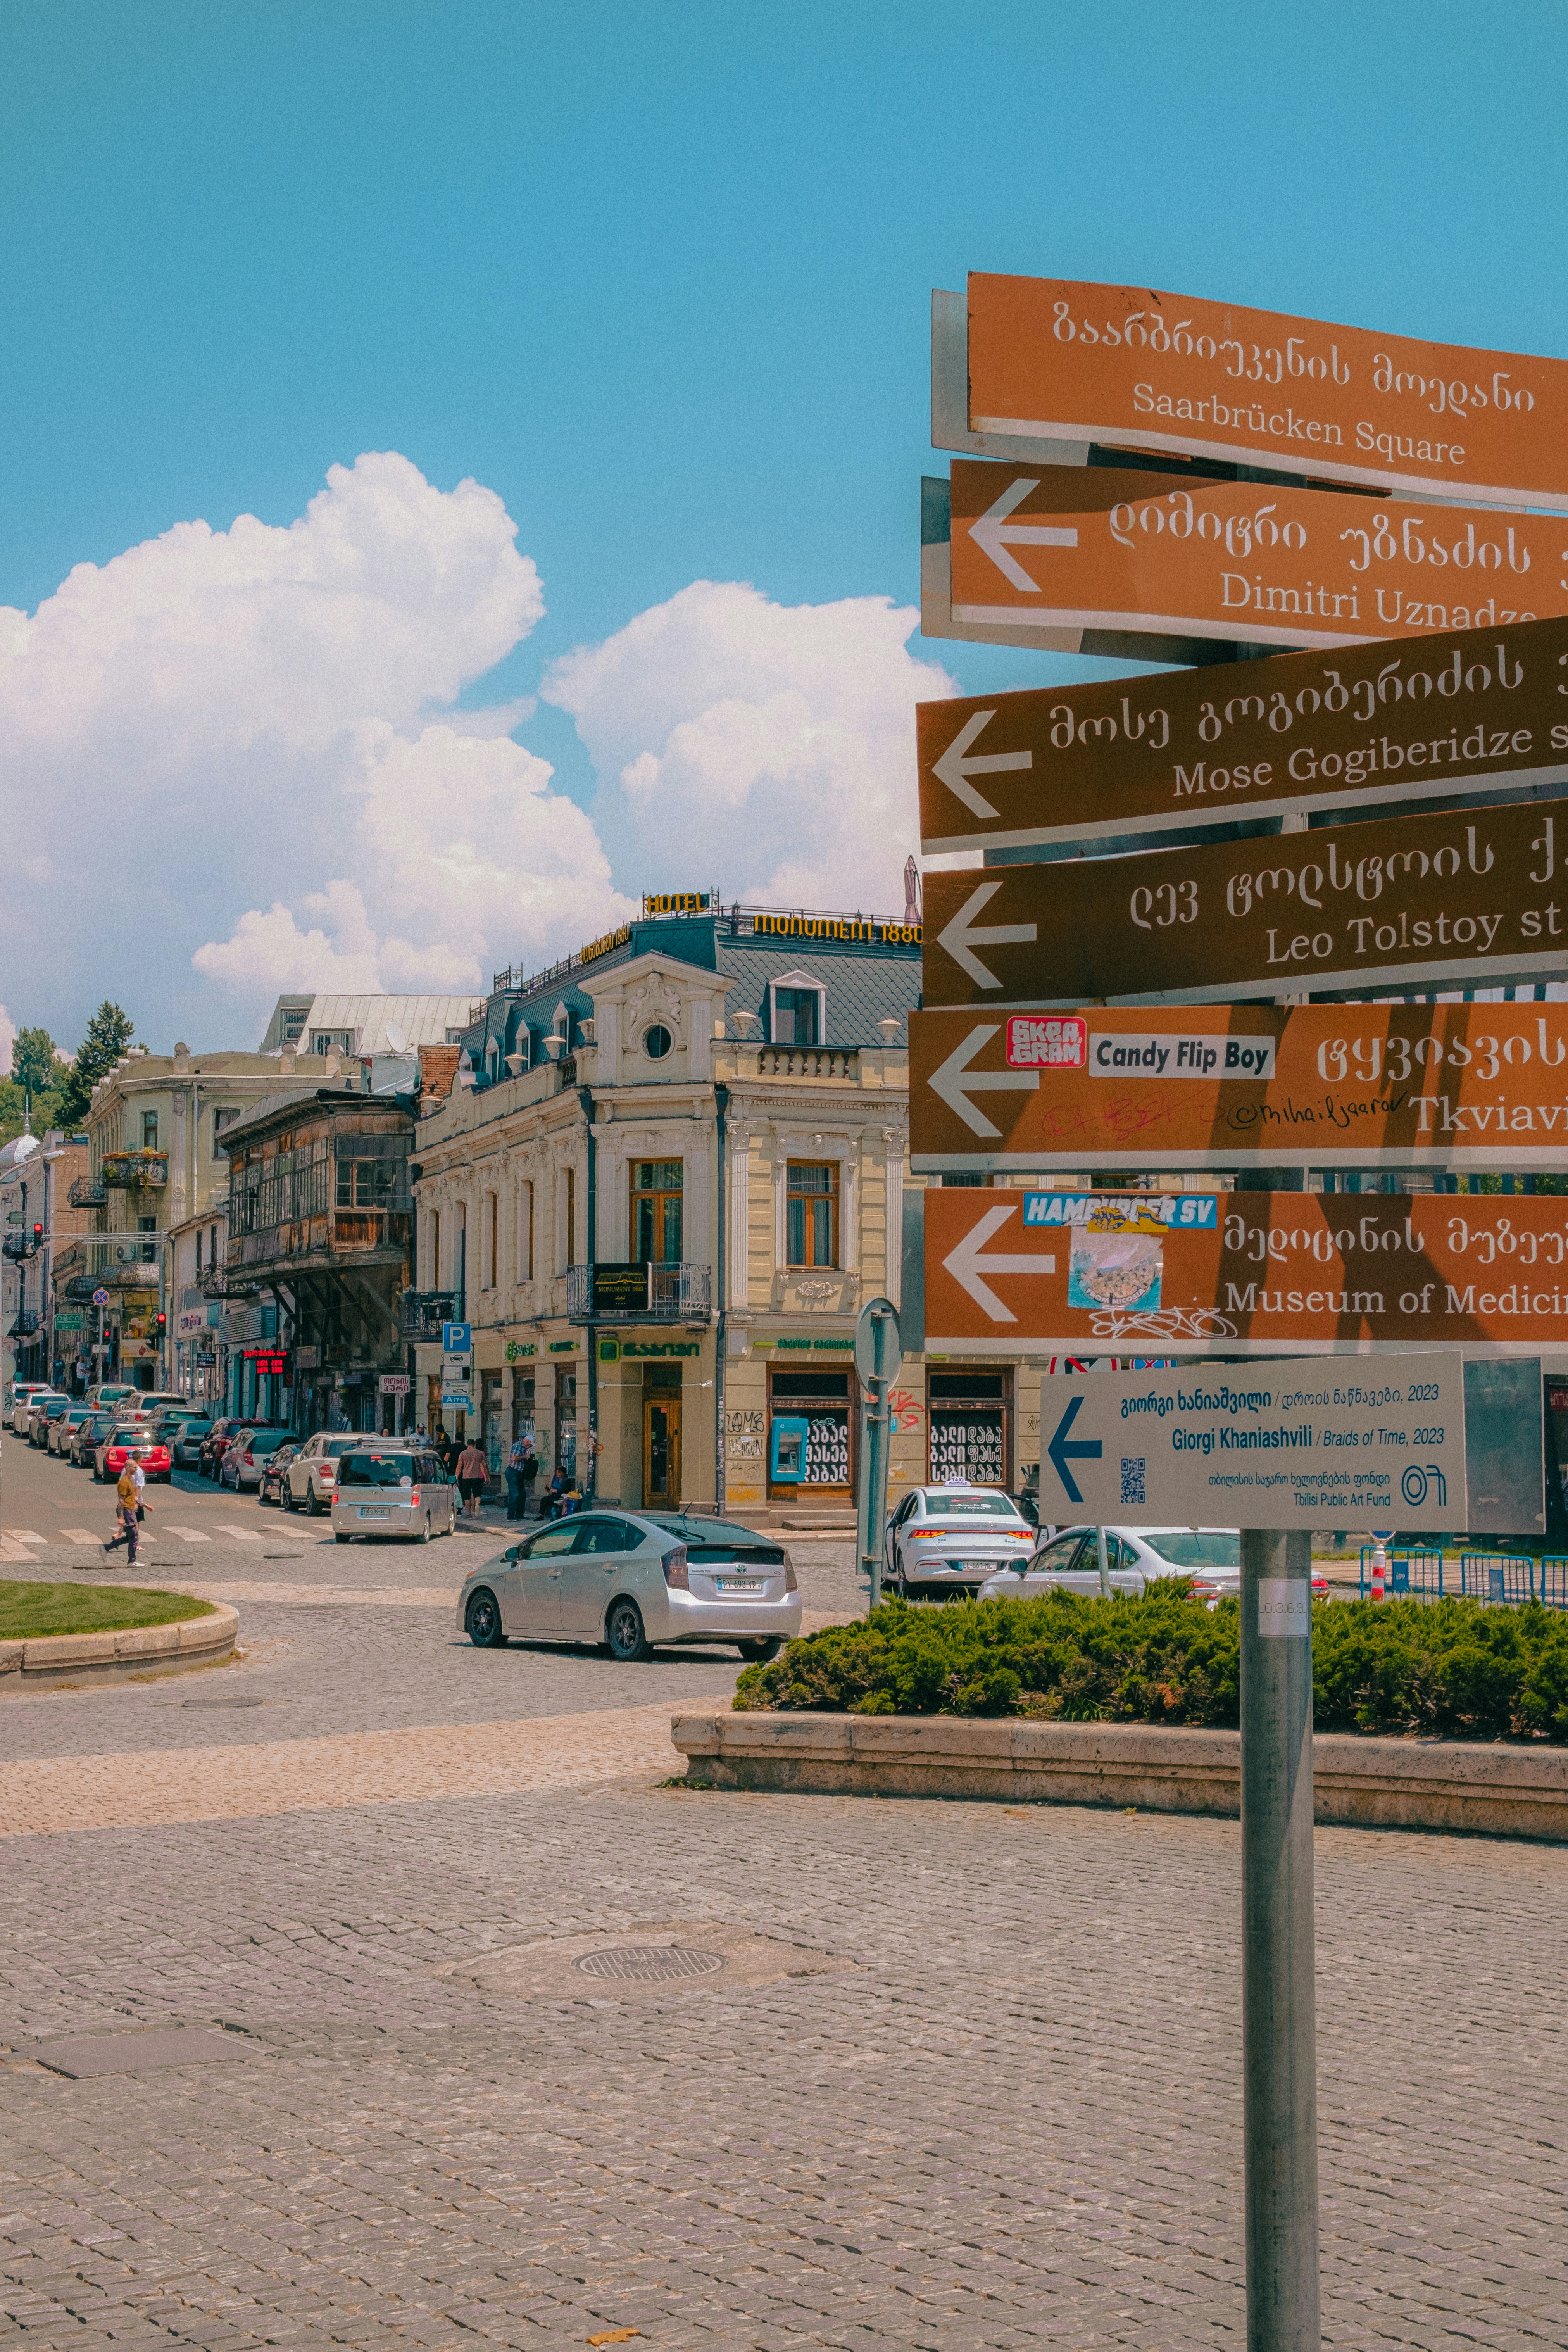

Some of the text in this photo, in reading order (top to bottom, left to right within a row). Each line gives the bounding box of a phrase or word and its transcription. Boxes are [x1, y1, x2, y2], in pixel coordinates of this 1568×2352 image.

[1052, 302, 1534, 419] ზაარბრიუკენის მოედანი
[1133, 383, 1466, 465] Saarbrücken Square
[1109, 491, 1307, 558] დიმიტრი
[1340, 514, 1531, 571] უზნაძის
[1221, 573, 1360, 619] Dimitri
[1051, 698, 1169, 749] მოსე
[1198, 644, 1523, 742] გოგიბერიძის
[1174, 760, 1273, 796] Mose
[1288, 724, 1532, 782] Gogiberidze
[1131, 880, 1198, 930] ლევ
[1226, 826, 1494, 917] ტოლსტოის
[647, 892, 708, 913] HOTEL
[754, 914, 923, 943] MONUMENT 1880
[1267, 928, 1333, 963] Leo
[1347, 912, 1504, 951] Tolstoy
[1097, 1040, 1269, 1075] Candy Flip Boy
[1318, 1018, 1566, 1082] ტყვიავის
[1180, 1200, 1214, 1223] SV
[1224, 1215, 1568, 1264] მედიცინის მუზეუ
[1225, 1283, 1568, 1314] Museum of Medici
[450, 1327, 464, 1348] P
[1121, 1391, 1173, 1418] გიორგი
[1178, 1387, 1271, 1414] ხანიაშვილი
[1282, 1389, 1329, 1410] დროის
[1408, 1384, 1439, 1401] 2023
[1172, 1428, 1214, 1455] Giorgi
[1220, 1425, 1312, 1448] Khaniashvili
[1323, 1430, 1359, 1446] Braids
[1362, 1429, 1374, 1446] of
[1377, 1429, 1409, 1447] Time,
[1413, 1427, 1444, 1444] 2023
[1209, 1471, 1390, 1488] თბილისის საჯარო ხელოვნების ფონდი
[1294, 1493, 1390, 1506] Tbilisi Public Art Fund
[723, 1579, 756, 1589] PY-698-YP
